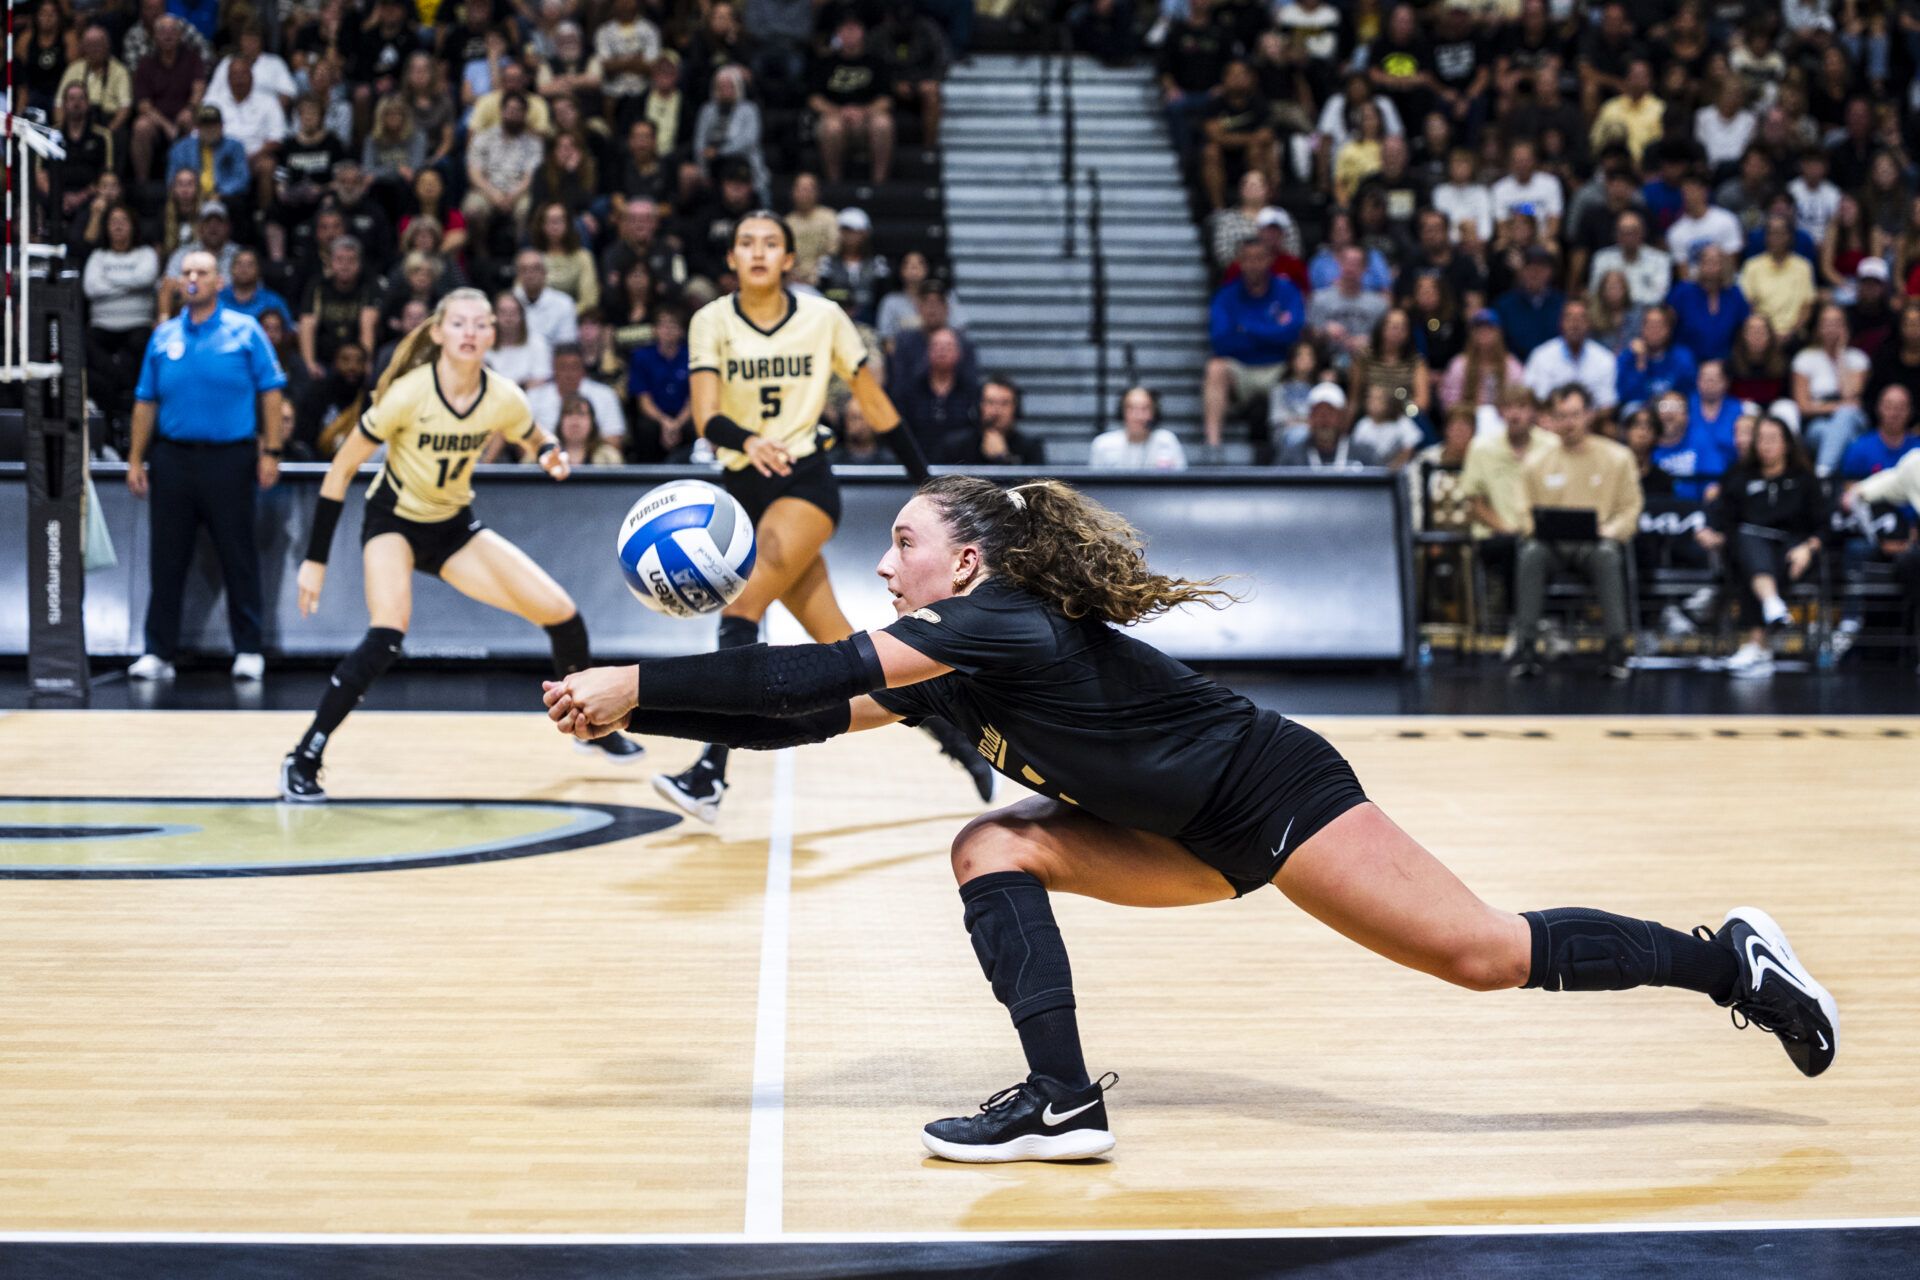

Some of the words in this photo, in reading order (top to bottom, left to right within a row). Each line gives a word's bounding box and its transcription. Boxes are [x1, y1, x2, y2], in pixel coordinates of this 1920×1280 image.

[727, 356, 812, 381] PURDUE
[761, 386, 781, 419] 5
[629, 494, 677, 528] PURDUE
